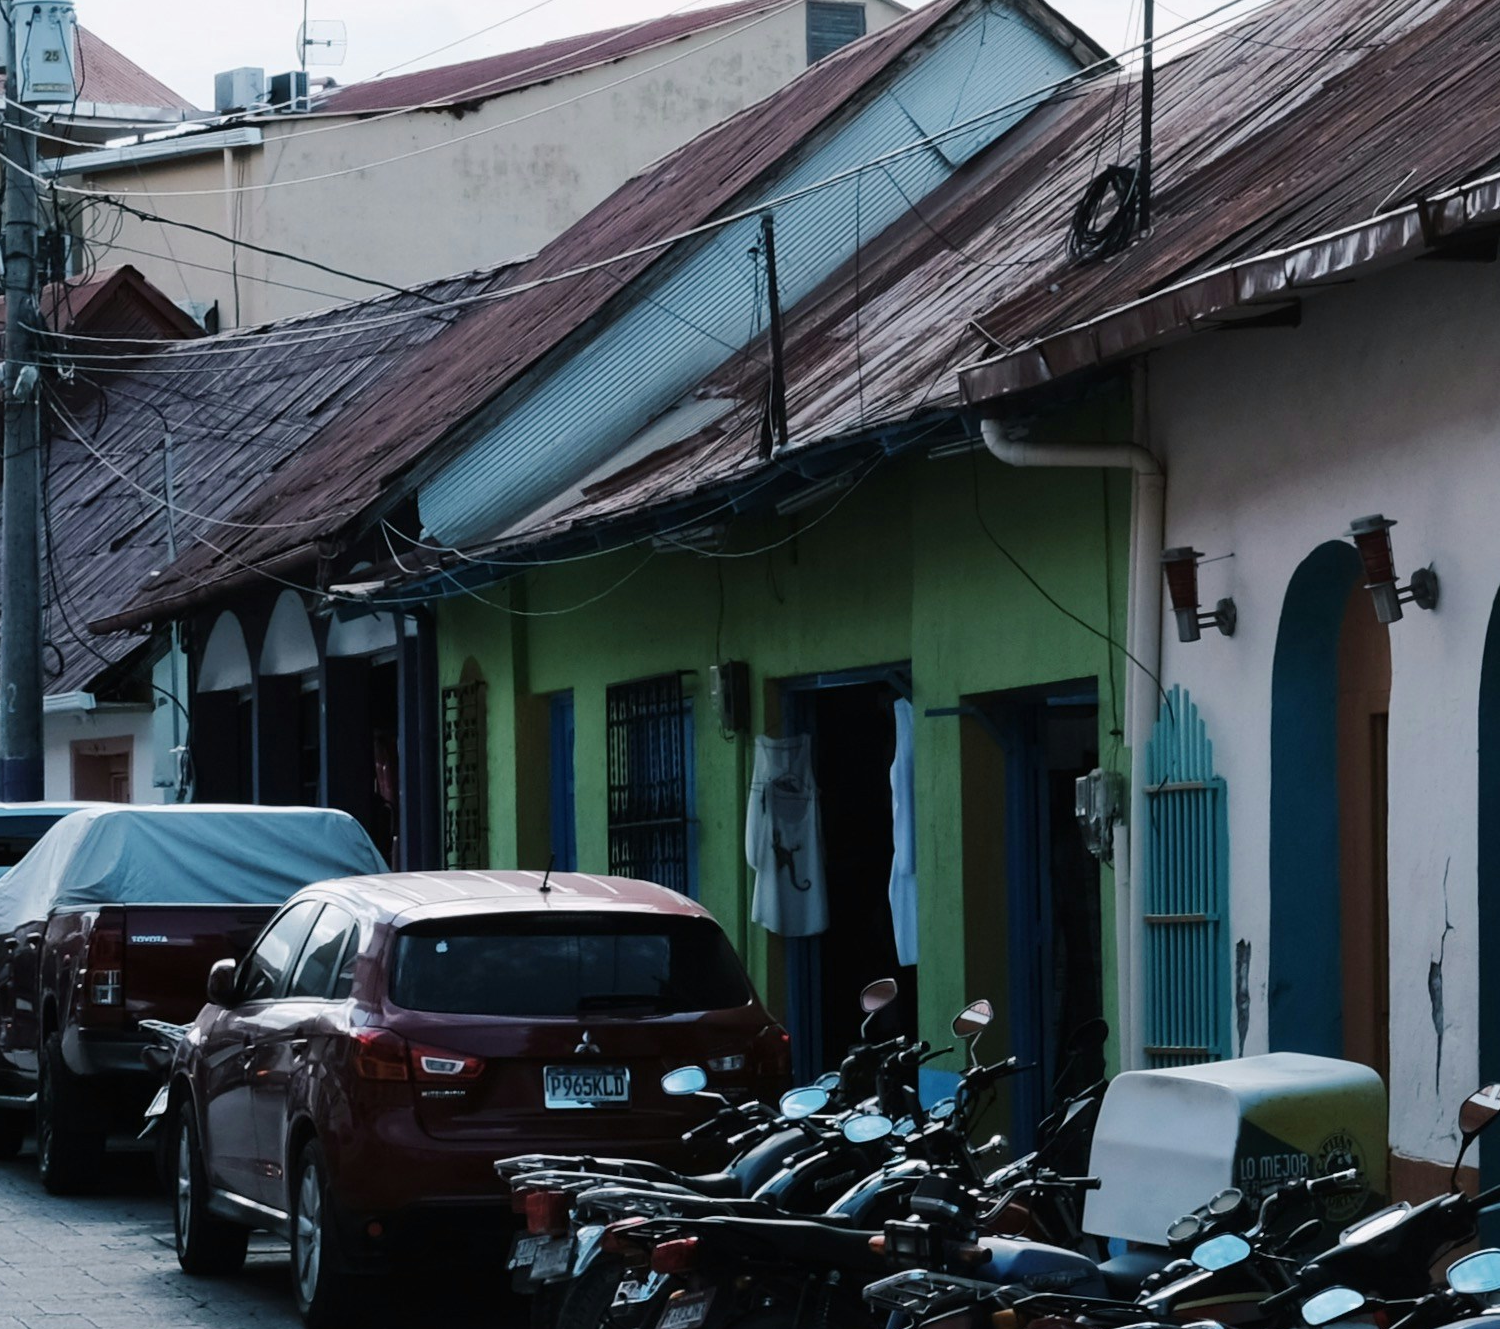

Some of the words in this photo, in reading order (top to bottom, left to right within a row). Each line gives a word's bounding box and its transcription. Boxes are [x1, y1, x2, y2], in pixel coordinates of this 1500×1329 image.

[44, 50, 60, 62] 25
[131, 935, 169, 943] TOYOTA
[551, 1076, 626, 1097] P965KLD
[1240, 1155, 1256, 1181] LO
[1260, 1152, 1310, 1179] MEJOR
